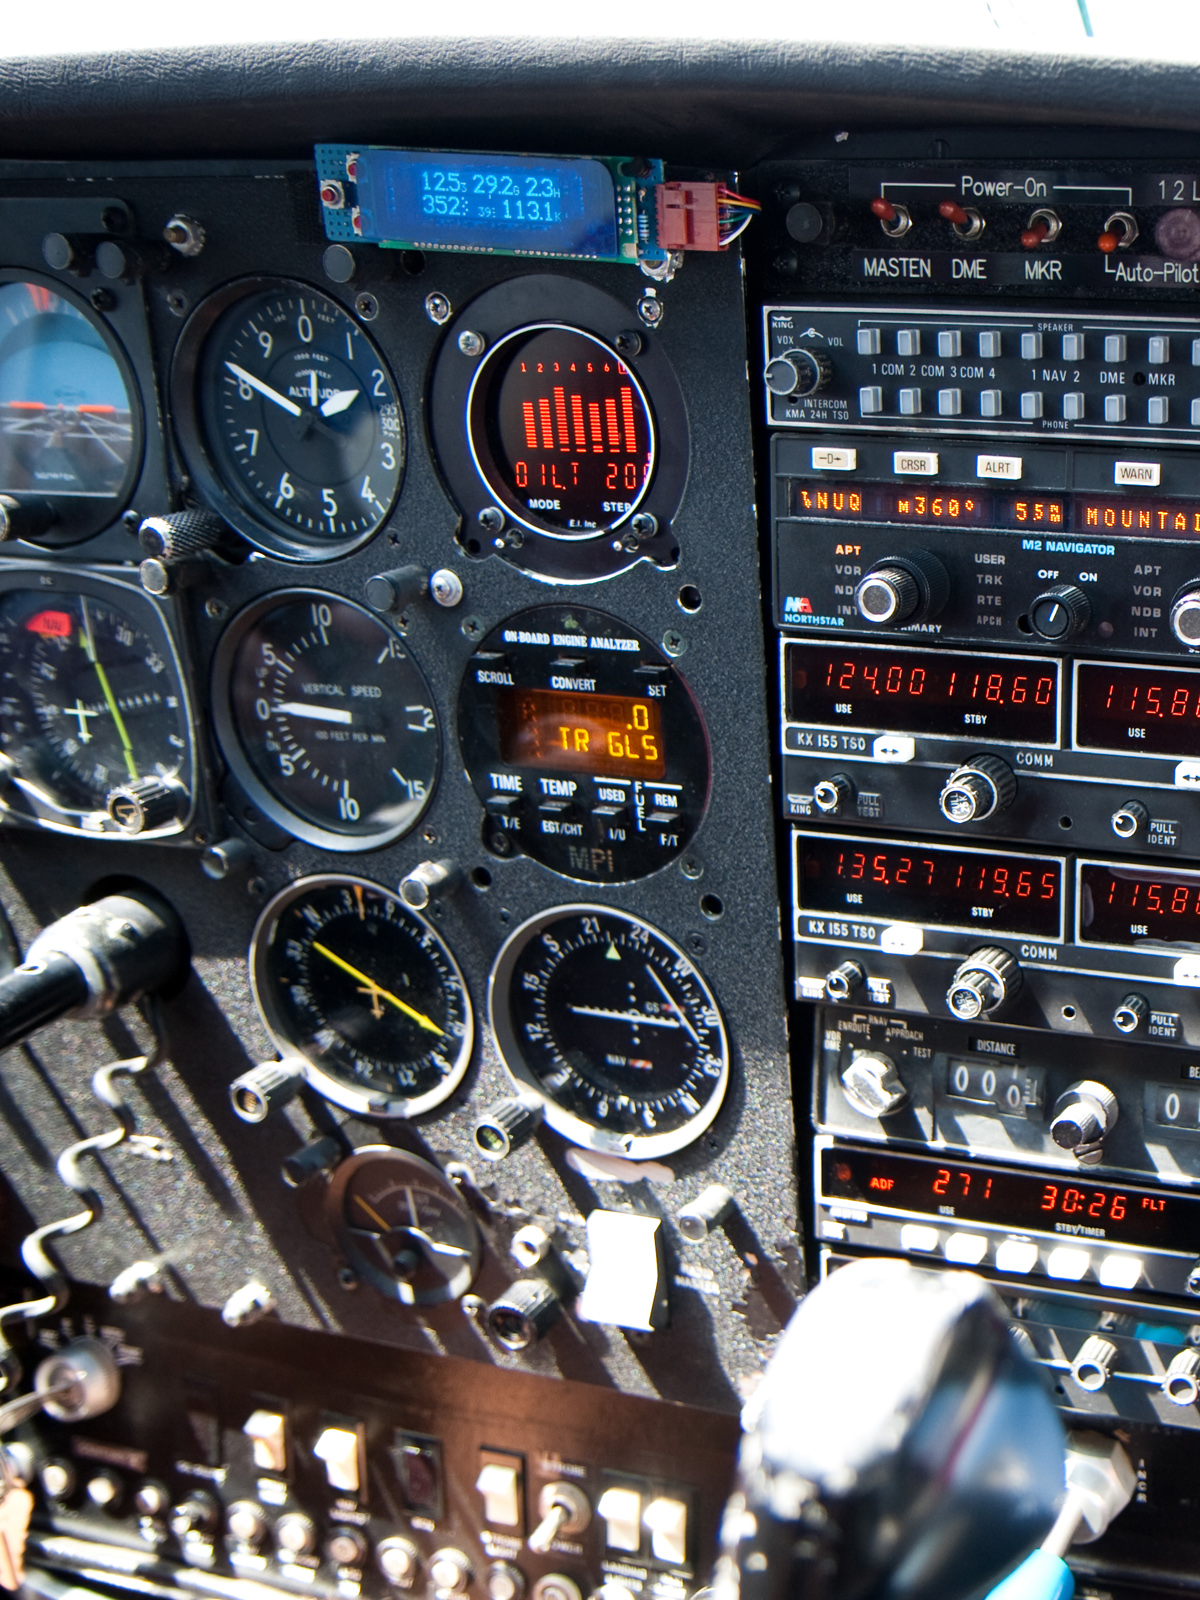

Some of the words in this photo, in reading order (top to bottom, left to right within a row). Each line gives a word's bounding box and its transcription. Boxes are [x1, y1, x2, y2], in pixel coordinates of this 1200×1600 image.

[962, 176, 1047, 197] Power-On
[864, 257, 931, 278] MASTEN
[952, 259, 987, 279] DME
[1025, 260, 1062, 280] MKR
[1115, 262, 1199, 283] Auto-Pilot
[1038, 323, 1073, 332] SPEAKER
[777, 335, 794, 345] VOX
[828, 337, 843, 346] VOL
[881, 364, 904, 376] COM
[921, 365, 944, 377] COM
[960, 367, 984, 378] COM
[1042, 370, 1066, 382] NAV
[1100, 373, 1125, 384] DME
[1148, 374, 1175, 386] MKR
[804, 399, 847, 409] INTERCOM
[785, 409, 805, 419] KMA
[810, 410, 827, 419] 24H
[833, 410, 849, 420] TSO
[1042, 420, 1068, 429] PHONE
[901, 459, 926, 471] CRSR
[985, 462, 1011, 473] ALRT
[1121, 468, 1152, 480] WARN
[529, 499, 560, 510] MODE
[604, 502, 632, 512] STEP
[585, 520, 596, 528] Inc
[836, 545, 861, 555] APT
[1022, 540, 1042, 550] M2
[1046, 541, 1114, 556] NAVIGATOR
[974, 554, 1006, 564] USER
[835, 564, 861, 575] VOR
[1038, 570, 1059, 579] OFF
[1134, 565, 1162, 575] APT
[977, 574, 1002, 585] TRK
[1079, 572, 1098, 582] ON
[1133, 586, 1162, 596] VOR
[977, 596, 1001, 606] RTE
[1132, 606, 1161, 618] NDB
[784, 614, 844, 626] NORTHSTAR
[977, 615, 1001, 626] APCH
[1134, 627, 1157, 638] INT
[504, 631, 550, 644] ON-BOARD
[553, 635, 587, 647] ENGINE
[590, 637, 640, 651] ANALYZER
[478, 671, 514, 685] SCROLL
[552, 677, 596, 691] CONVERT
[826, 663, 925, 695] 124.00
[949, 672, 1052, 705] 118.60
[303, 683, 345, 696] VERTICAL
[351, 686, 382, 698] SPEED
[649, 685, 666, 697] SET
[836, 704, 852, 713] USE
[965, 714, 986, 724] STBY
[1128, 728, 1146, 738] USE
[797, 733, 813, 746] KX
[818, 734, 838, 748] 155
[843, 736, 866, 750] TSO
[1016, 752, 1053, 767] COMM
[491, 774, 523, 792] TIME
[540, 779, 577, 797] TEMP
[599, 789, 625, 802] USED
[655, 794, 677, 807] REM
[542, 821, 583, 836] EGT/CHT
[1151, 823, 1174, 834] PULL
[1148, 834, 1177, 846] IDENT
[569, 846, 614, 872] MPI
[837, 854, 934, 884] 135.27
[956, 866, 1055, 899] 119.65
[838, 1021, 870, 1034] ENROUTE
[886, 1029, 924, 1041] APPROACH
[913, 1047, 931, 1059] TEST
[977, 1039, 1016, 1055] DISTANCE
[870, 1177, 894, 1190] ADF
[933, 1170, 993, 1199] 271
[1041, 1186, 1127, 1220] 30:26
[1142, 1198, 1166, 1211] FLT
[1056, 1222, 1105, 1238] STBY/TIMER
